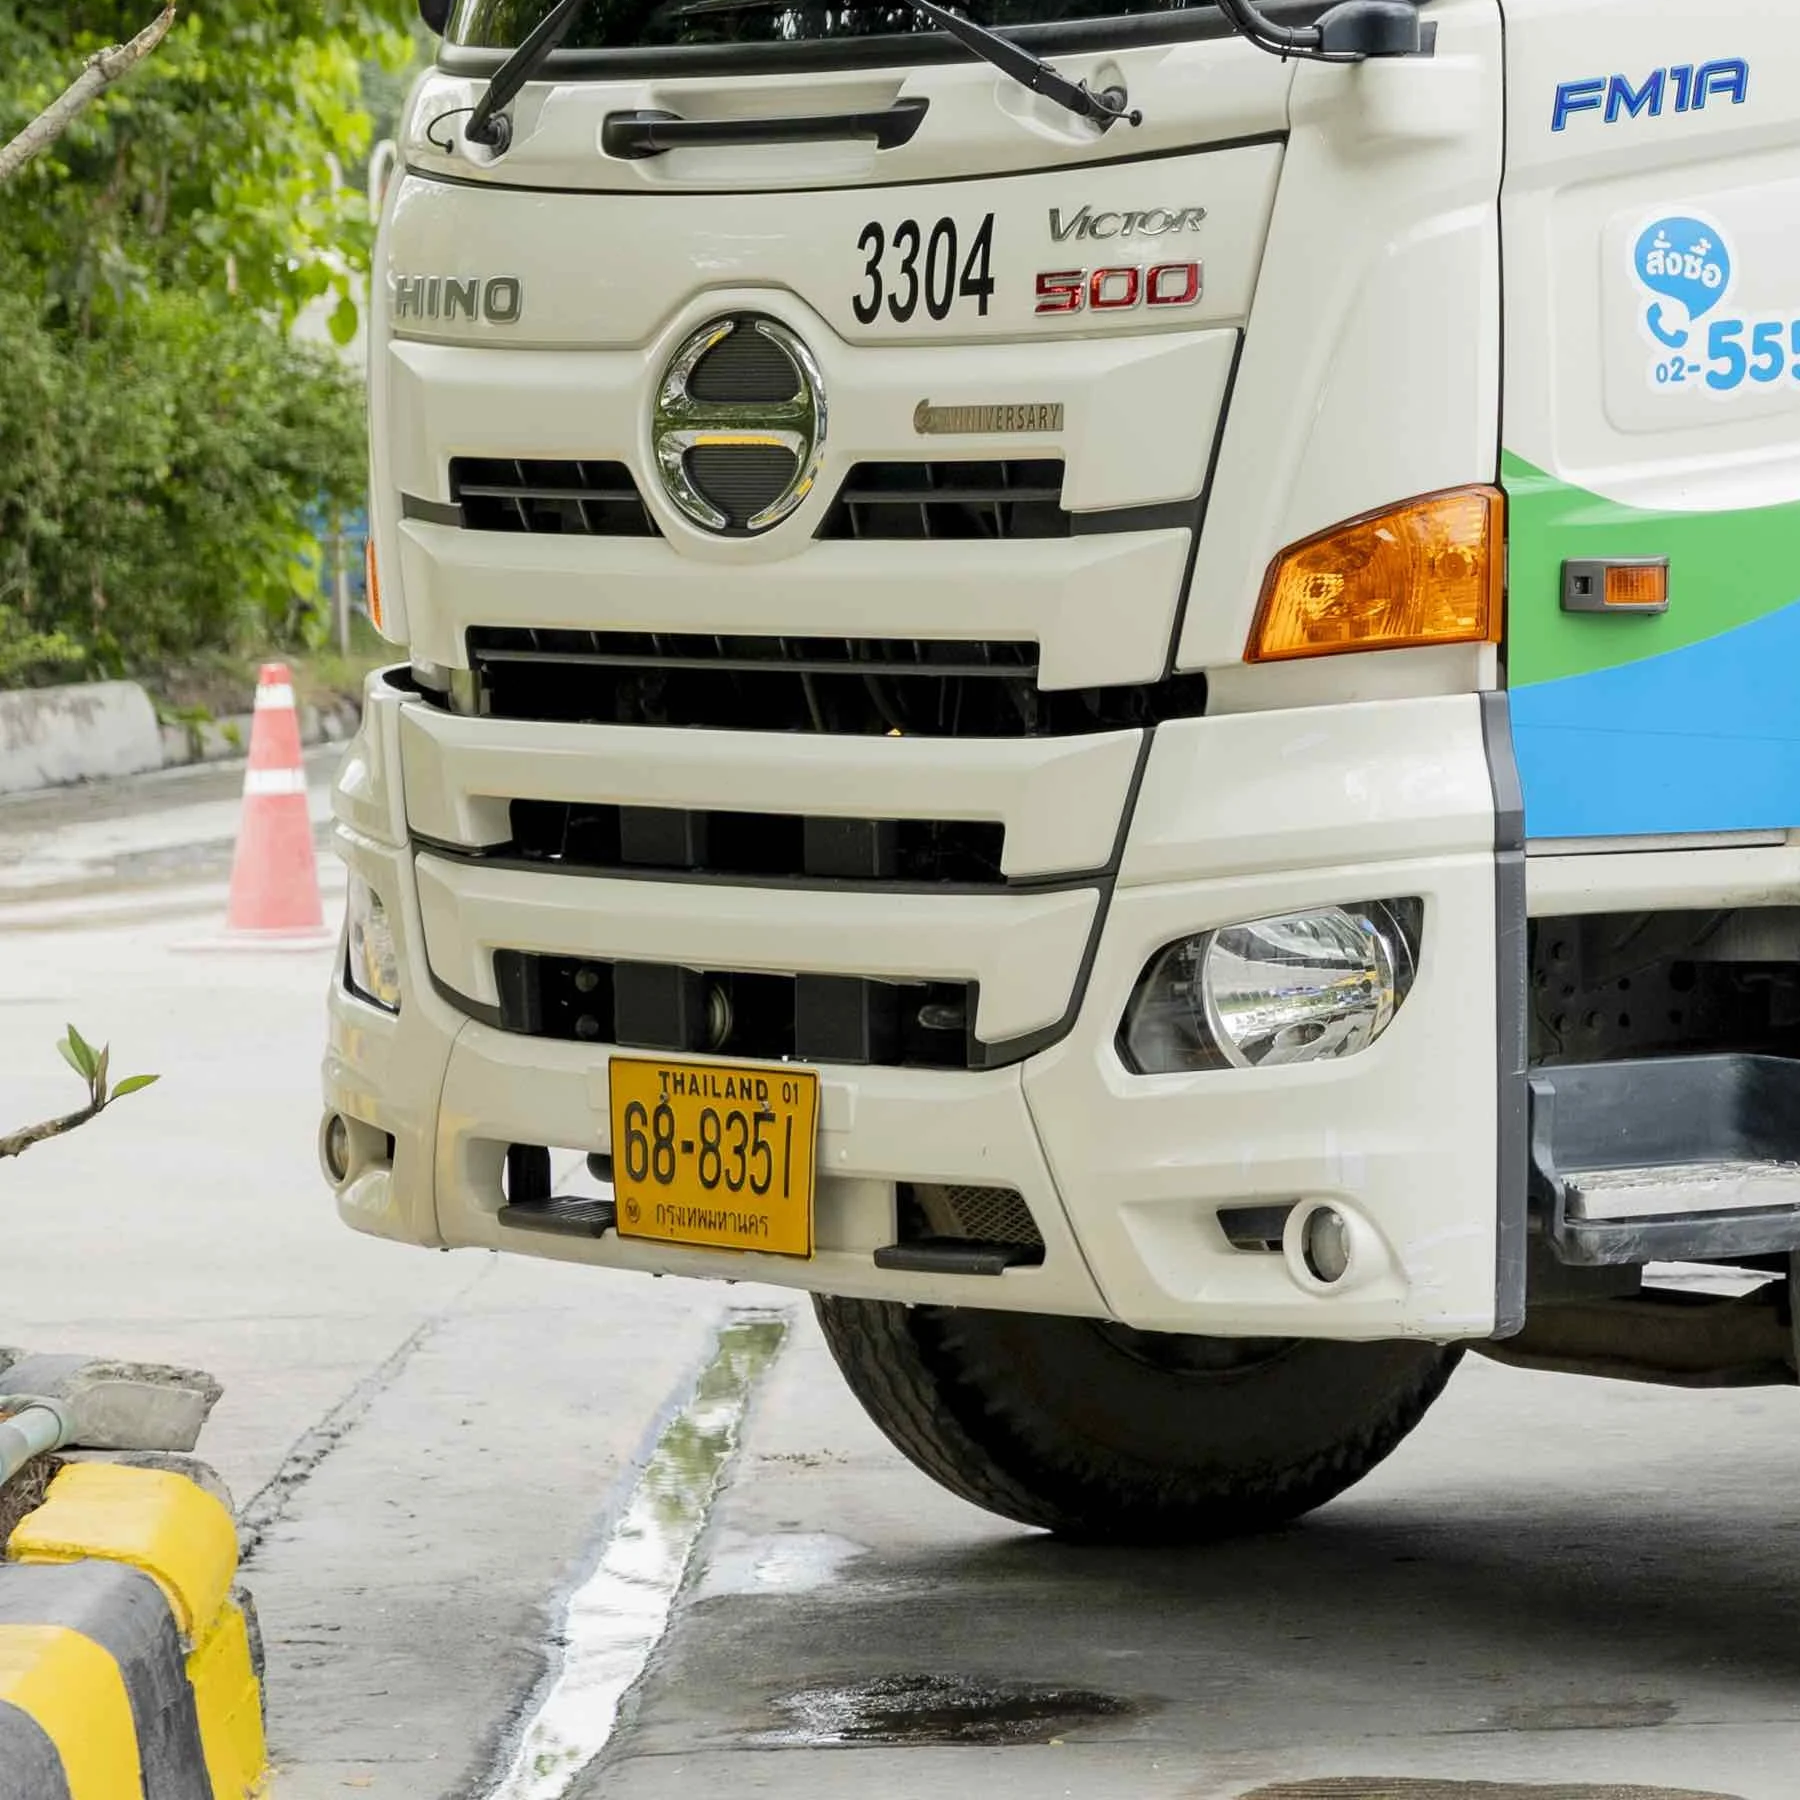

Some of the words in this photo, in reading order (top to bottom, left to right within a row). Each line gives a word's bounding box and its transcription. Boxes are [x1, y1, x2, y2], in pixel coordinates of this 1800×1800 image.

[1551, 56, 1750, 131] FM1A
[852, 212, 995, 325] 3304
[1034, 258, 1203, 317] 500
[1646, 230, 1723, 289] สั่งซื้อ
[395, 274, 523, 325] HINO
[657, 1070, 769, 1101] THAILAND
[782, 1081, 799, 1104] 01
[624, 1100, 793, 1199] 68-8351
[656, 1202, 769, 1237] กรุงเทพมหานคร
